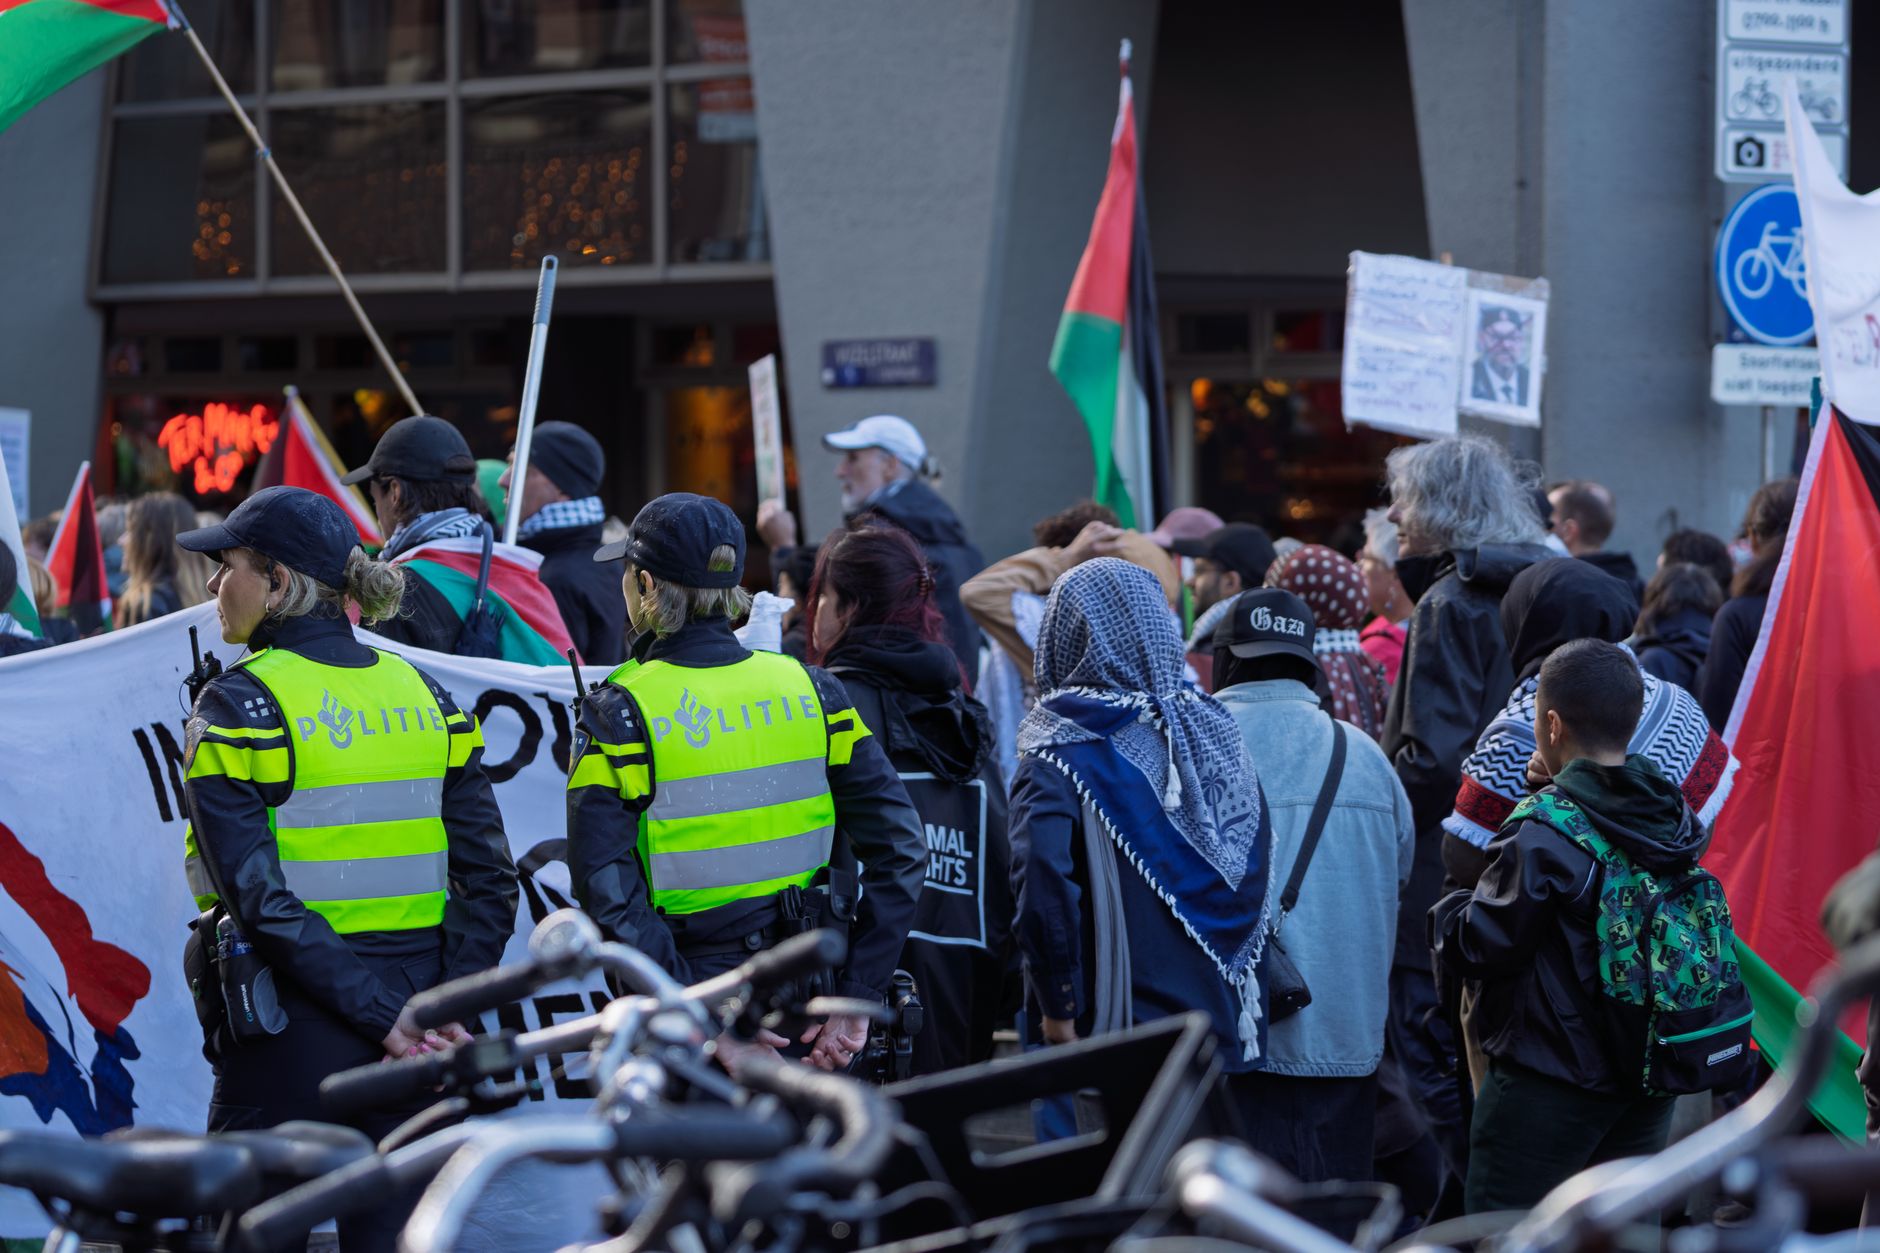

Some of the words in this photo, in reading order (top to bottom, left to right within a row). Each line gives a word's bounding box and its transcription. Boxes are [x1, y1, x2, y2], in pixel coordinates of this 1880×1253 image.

[1733, 56, 1839, 74] uitgezonderd
[1250, 606, 1305, 637] Gaza
[296, 698, 444, 749] POLITIE
[652, 691, 818, 749] POLITIE
[925, 823, 973, 858] MAL
[926, 852, 967, 887] HTS
